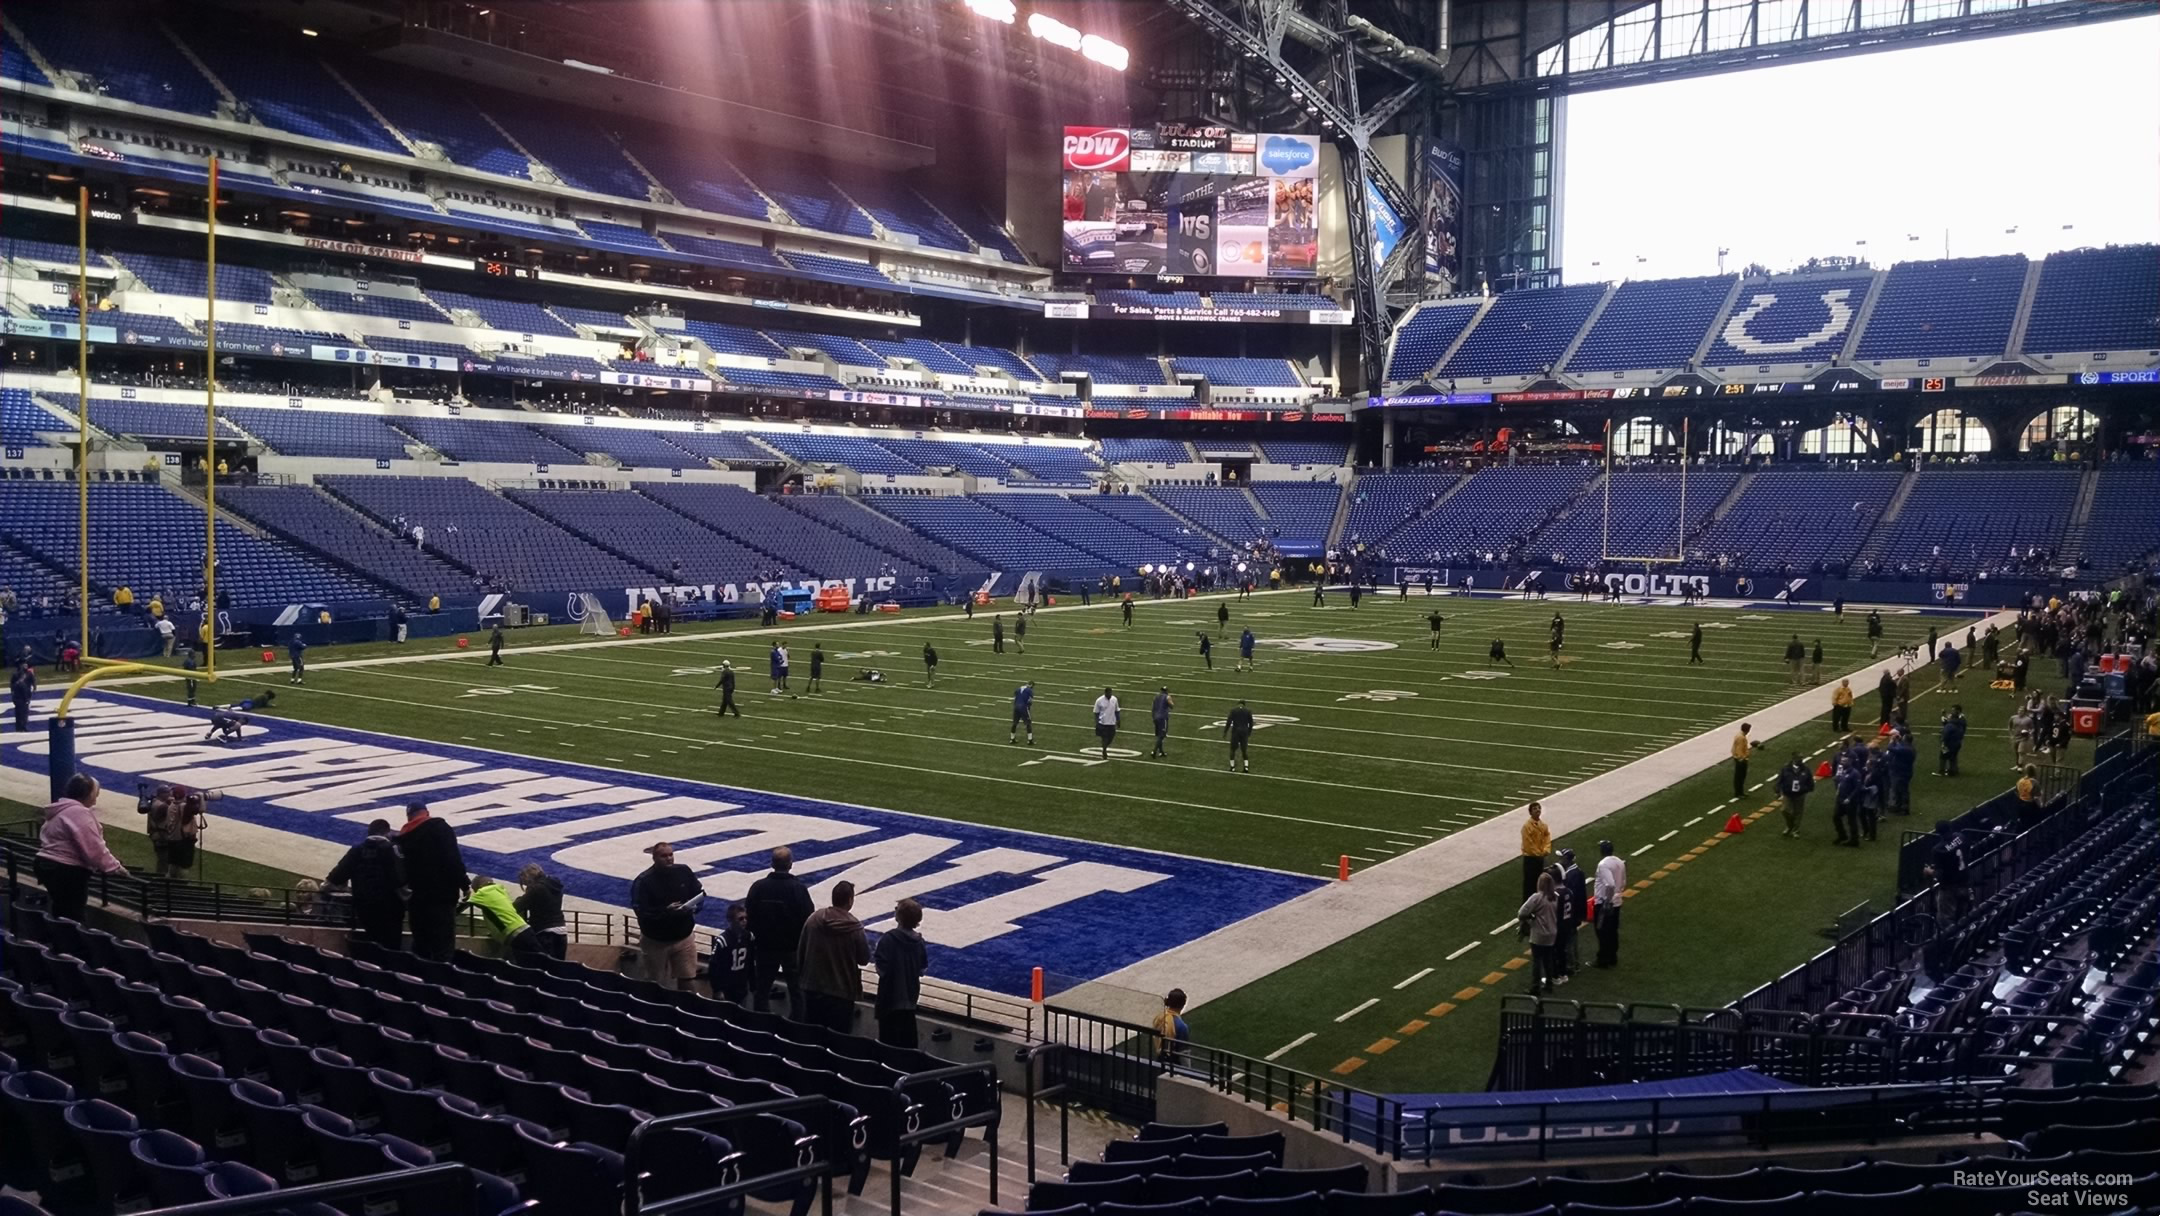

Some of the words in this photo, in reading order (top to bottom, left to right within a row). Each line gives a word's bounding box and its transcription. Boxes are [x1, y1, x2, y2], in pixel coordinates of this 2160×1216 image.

[1160, 125, 1202, 138] LUCAS
[1204, 127, 1227, 138] OIL
[1064, 136, 1119, 156] CDW
[1171, 139, 1216, 149] STADIUM
[1132, 151, 1190, 162] SHARP
[1268, 150, 1310, 160] salesforce
[1195, 182, 1215, 197] THE
[91, 210, 122, 221] verizon
[1183, 214, 1211, 239] VS
[303, 238, 343, 251] LUCAS
[346, 244, 364, 254] OIL
[368, 246, 423, 262] STADIUM
[1242, 241, 1265, 263] 4
[1130, 306, 1153, 315] Sales,
[1154, 307, 1175, 315] Parts
[1184, 308, 1213, 316] Service
[1214, 308, 1229, 316] Call
[169, 337, 186, 345] We'll
[223, 342, 242, 351] from
[511, 366, 530, 375] handle
[536, 369, 549, 377] from
[2111, 371, 2156, 382] SPORT
[1883, 379, 1907, 388] meijer
[1926, 379, 1942, 389] 25
[1974, 376, 2010, 385] LUCAS
[1725, 384, 1744, 394] 2:51
[1190, 411, 1223, 420] Available
[1227, 411, 1242, 420] Now
[6, 448, 23, 458] 137
[166, 455, 181, 464] 138
[1604, 573, 1710, 596] COLTS
[2080, 715, 2093, 728] G
[1037, 747, 1143, 766] 10
[731, 948, 747, 971] 12
